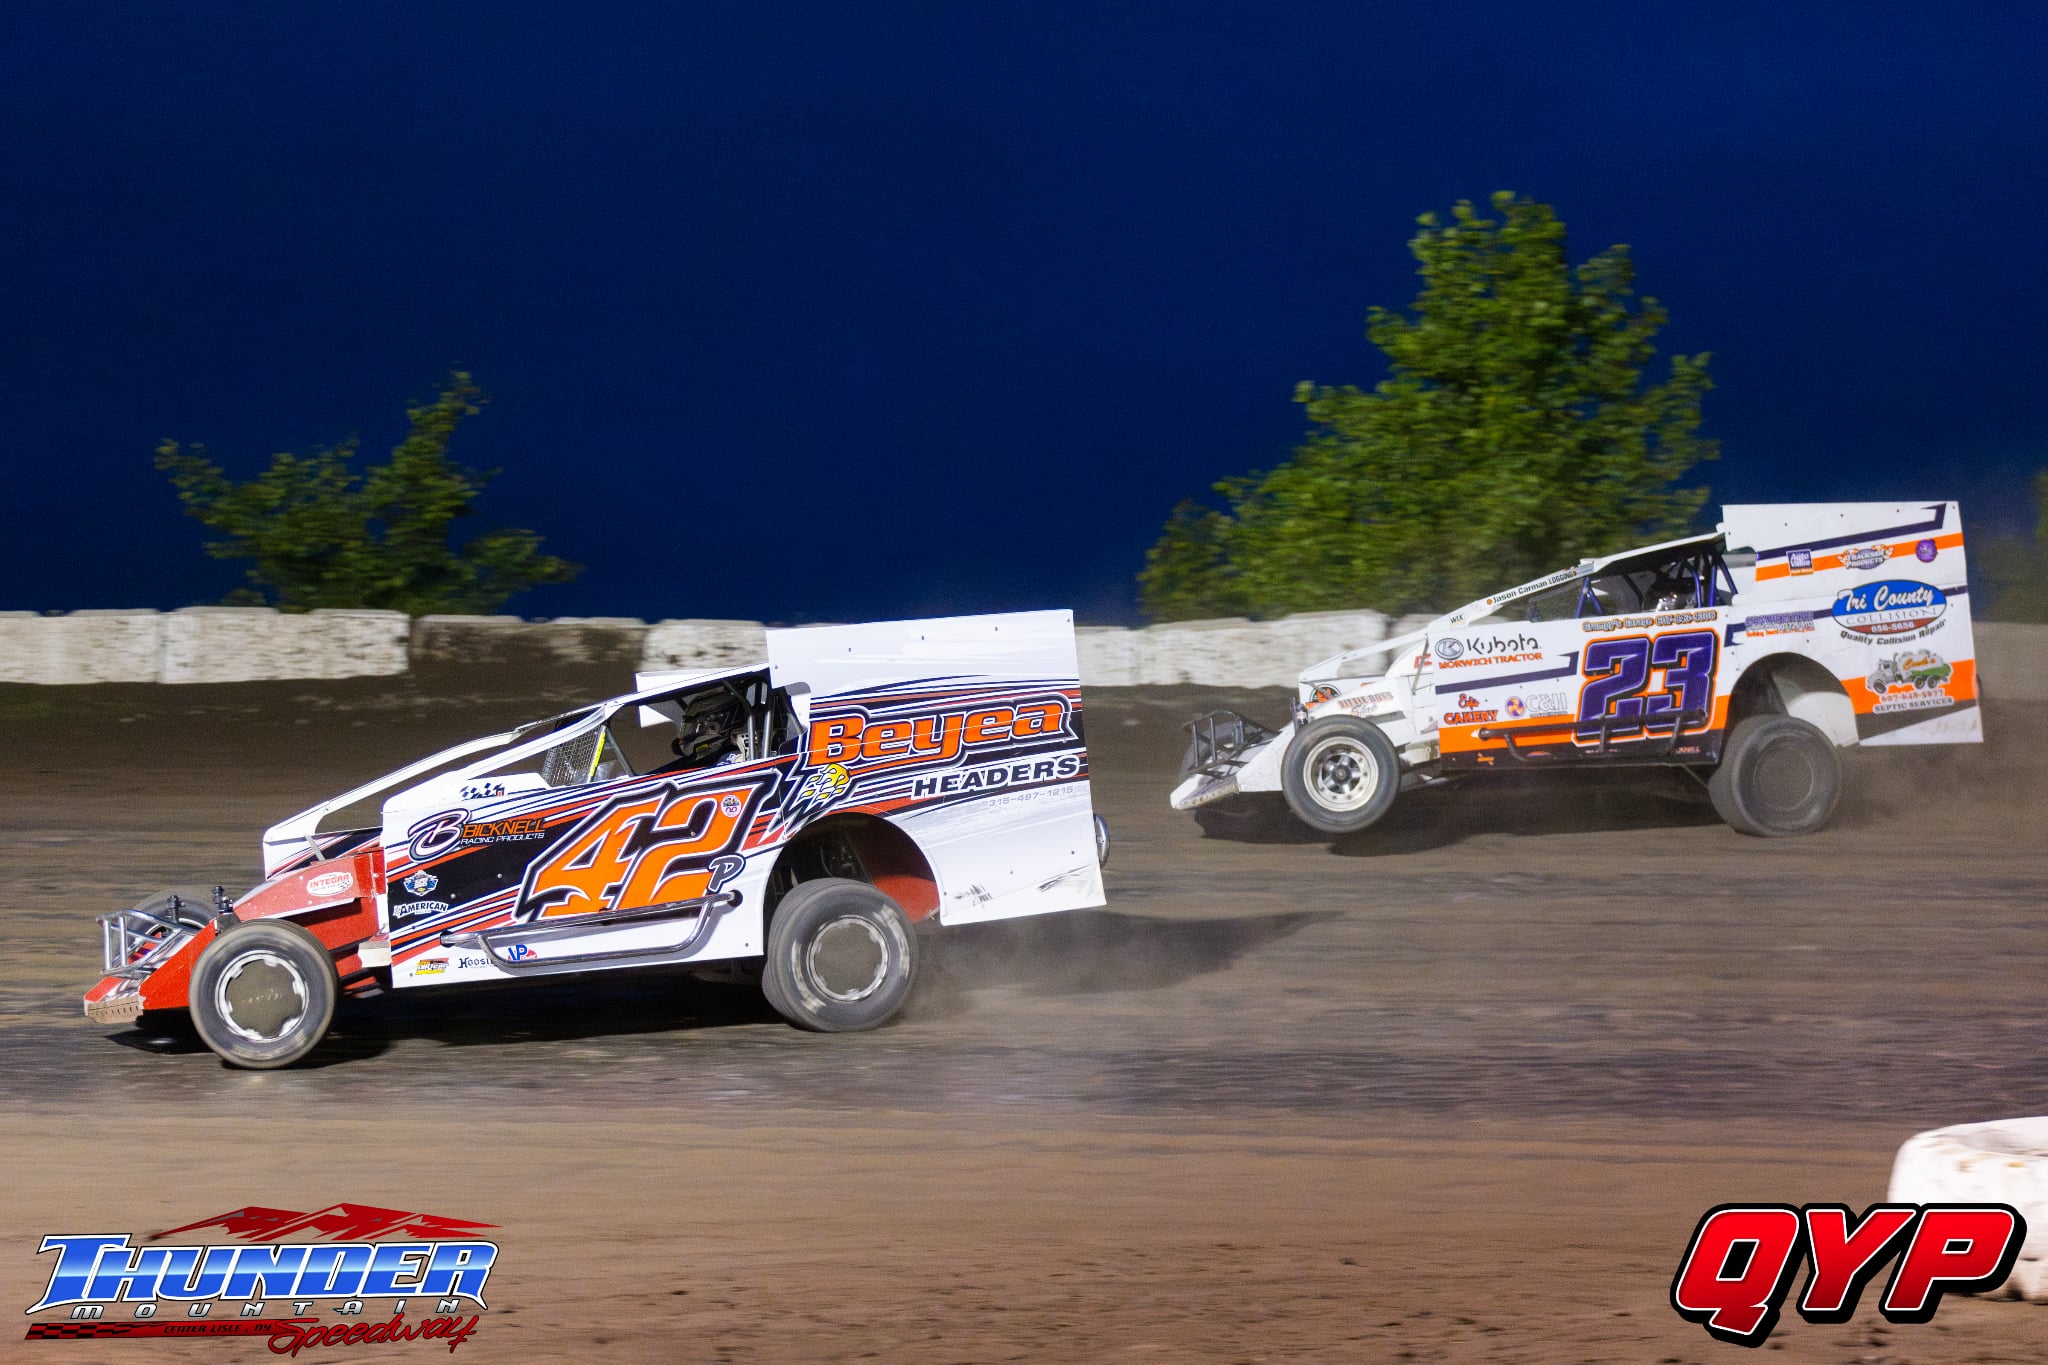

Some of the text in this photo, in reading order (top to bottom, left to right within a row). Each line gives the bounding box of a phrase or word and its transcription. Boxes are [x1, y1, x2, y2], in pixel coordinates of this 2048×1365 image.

[1790, 552, 1809, 561] Auto
[1790, 559, 1811, 568] Value
[1846, 557, 1884, 569] PRODUCTS
[1493, 591, 1517, 604] Jason
[1519, 580, 1548, 595] Carman
[1838, 585, 1935, 612] Tri County
[1846, 607, 1937, 625] COLLISION
[1839, 618, 1947, 645] Quality Collision Repair
[1467, 633, 1539, 655] Kubota
[1439, 656, 1493, 669] NORWICH
[1495, 652, 1543, 664] TRACTOR
[1575, 630, 1717, 741] 23
[1526, 692, 1568, 712] C&H
[1874, 698, 1953, 713] SEPTIC SERVICES
[1443, 709, 1499, 725] CAKERY
[807, 701, 1066, 767] Beyea
[913, 756, 1082, 798] HEADERS
[462, 819, 546, 838] BICKNELL
[460, 832, 545, 846] RACING PRODUCTS
[524, 777, 767, 918] 42
[309, 875, 350, 888] INTEGRA
[707, 853, 746, 893] P
[400, 902, 448, 916] AMERICAN
[507, 944, 528, 961] VP
